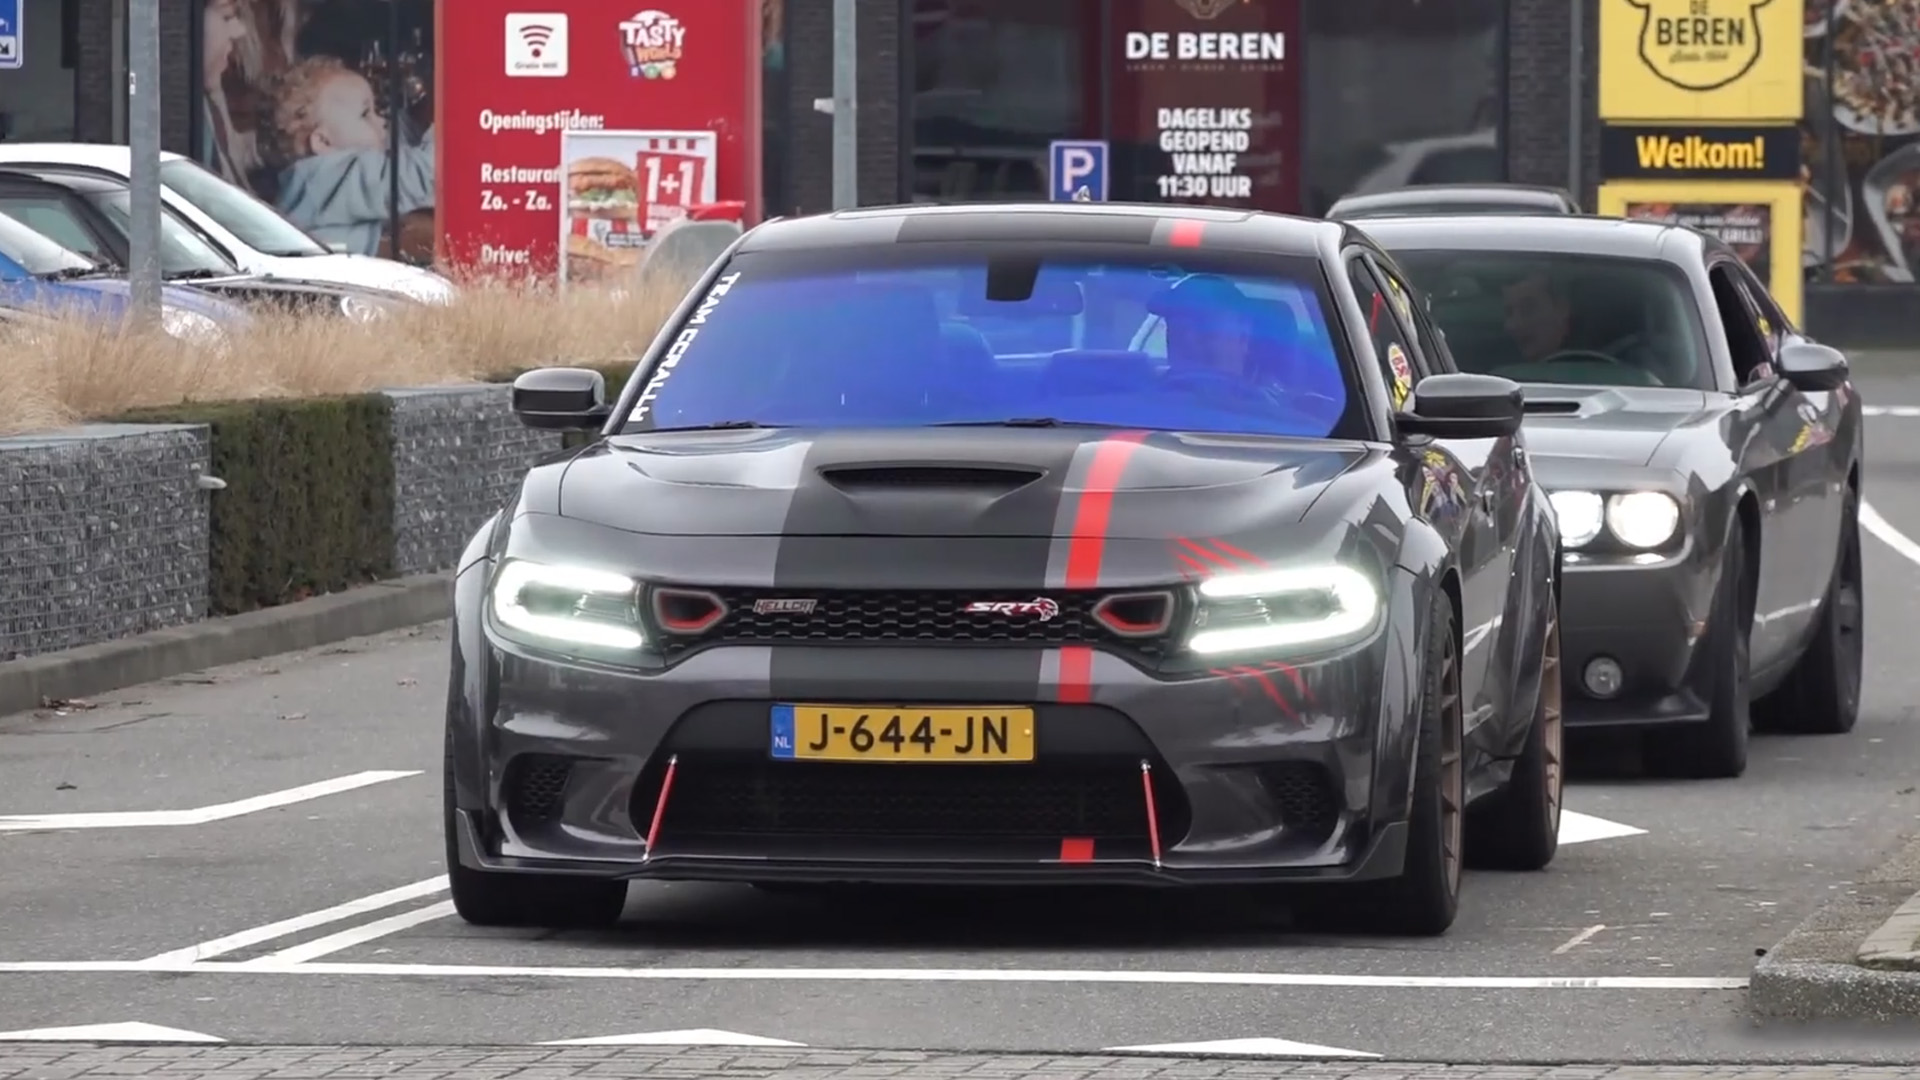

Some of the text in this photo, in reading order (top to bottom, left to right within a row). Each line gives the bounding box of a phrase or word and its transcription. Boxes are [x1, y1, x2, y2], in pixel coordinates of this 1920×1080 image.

[619, 19, 686, 47] TASTY
[1657, 18, 1744, 45] BEREN
[1126, 32, 1285, 59] DE BEREN
[479, 108, 605, 135] Openingstijden:
[1160, 130, 1250, 152] GEOPEND
[1636, 136, 1764, 169] Welkom!
[1063, 148, 1095, 192] P
[1172, 153, 1237, 174] VANAF
[645, 156, 695, 206] 1+1
[1157, 175, 1252, 197] 11:30 UUR
[480, 189, 508, 210] Zo.
[524, 189, 552, 210] Za.
[481, 244, 530, 265] Drive:
[689, 271, 741, 324] TEAM
[753, 599, 817, 615] HELLCAT
[965, 602, 1041, 616] SRT
[774, 713, 1008, 754] NL J-644-JN
